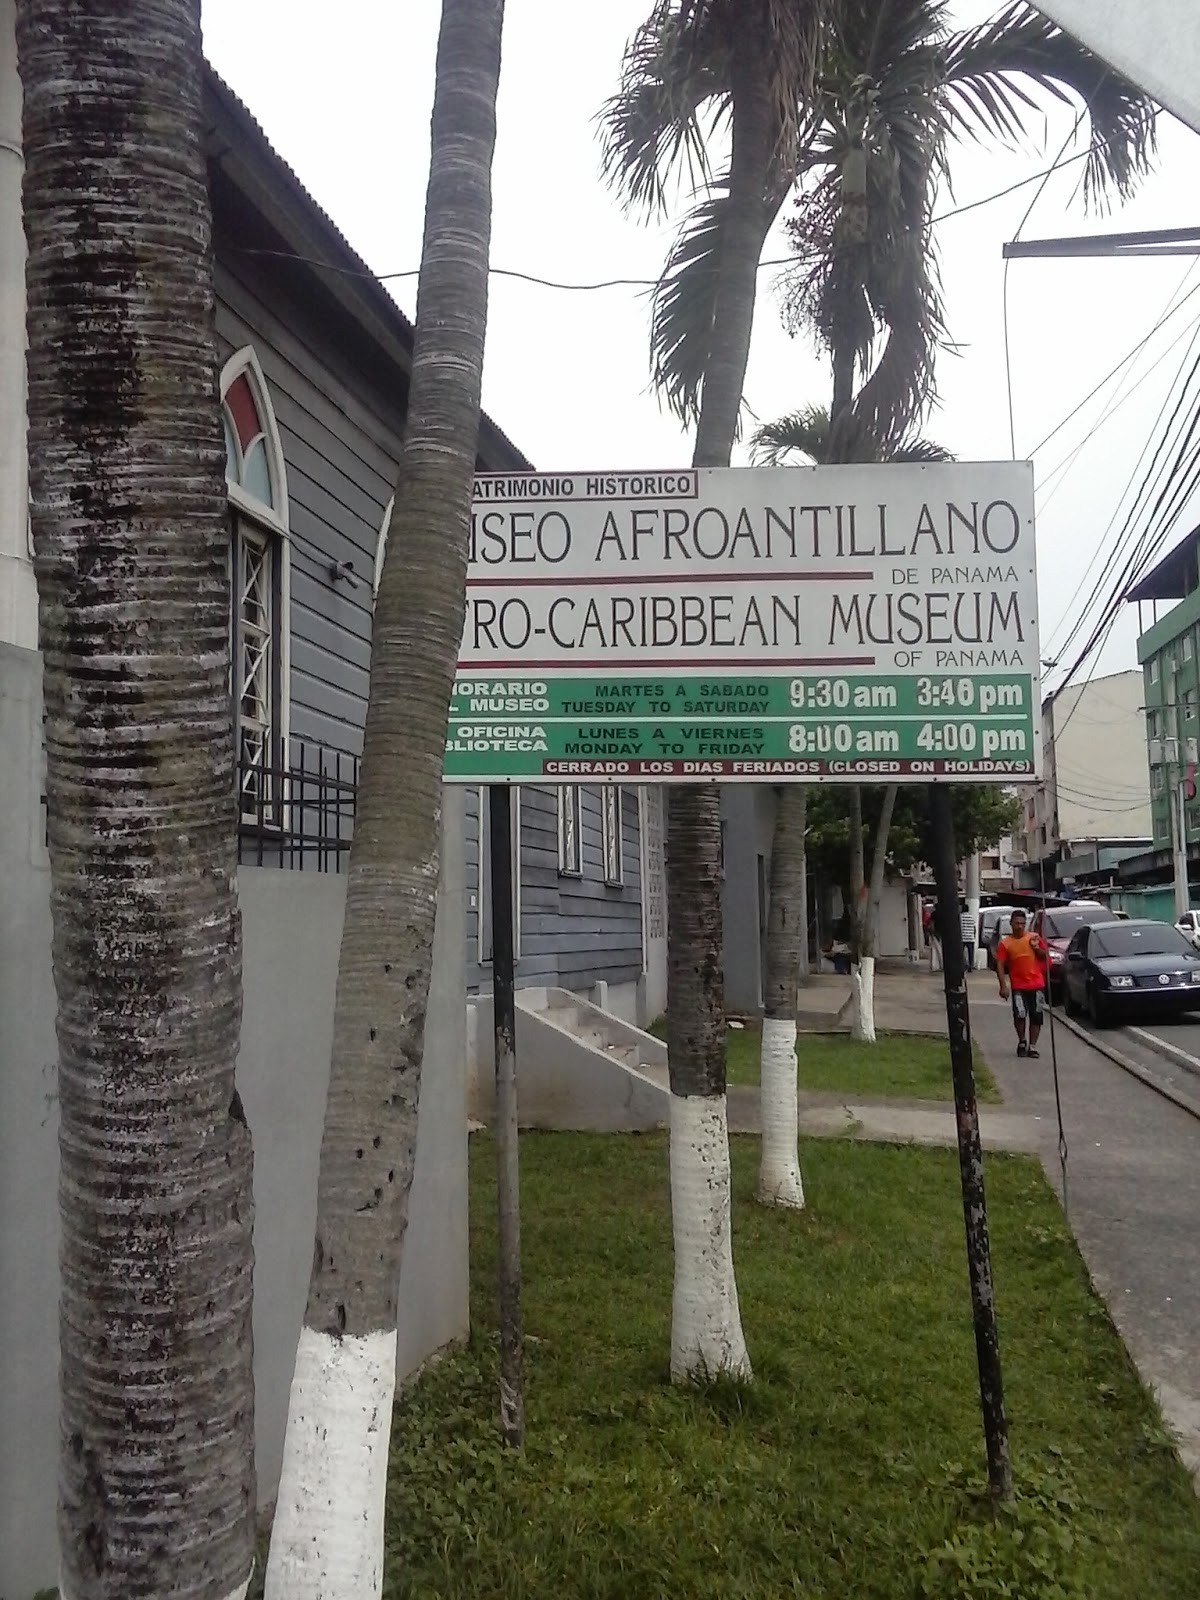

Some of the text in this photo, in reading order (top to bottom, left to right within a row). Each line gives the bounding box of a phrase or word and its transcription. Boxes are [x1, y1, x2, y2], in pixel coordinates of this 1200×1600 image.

[586, 475, 690, 497] HISTORICO
[595, 500, 1020, 562] AFROANTILLANO
[891, 565, 1019, 585] DE PANAMA
[465, 591, 1025, 651] RO-CARIBBEAN MUSEUM
[894, 649, 1024, 668] OF PANAMA
[595, 684, 769, 697] MARTES A SABADO
[470, 698, 550, 712] MUSEO
[561, 701, 770, 713] TUESDAY TO SATURDAY
[457, 726, 547, 738] OFICINA
[578, 727, 764, 739] LUNES A VIERNES
[565, 743, 765, 754] MONDAY TO FRIDAY
[546, 760, 1031, 774] CERRADO LOS DIAS FERIADOS (CLOSED ON HOLIDAYS)
